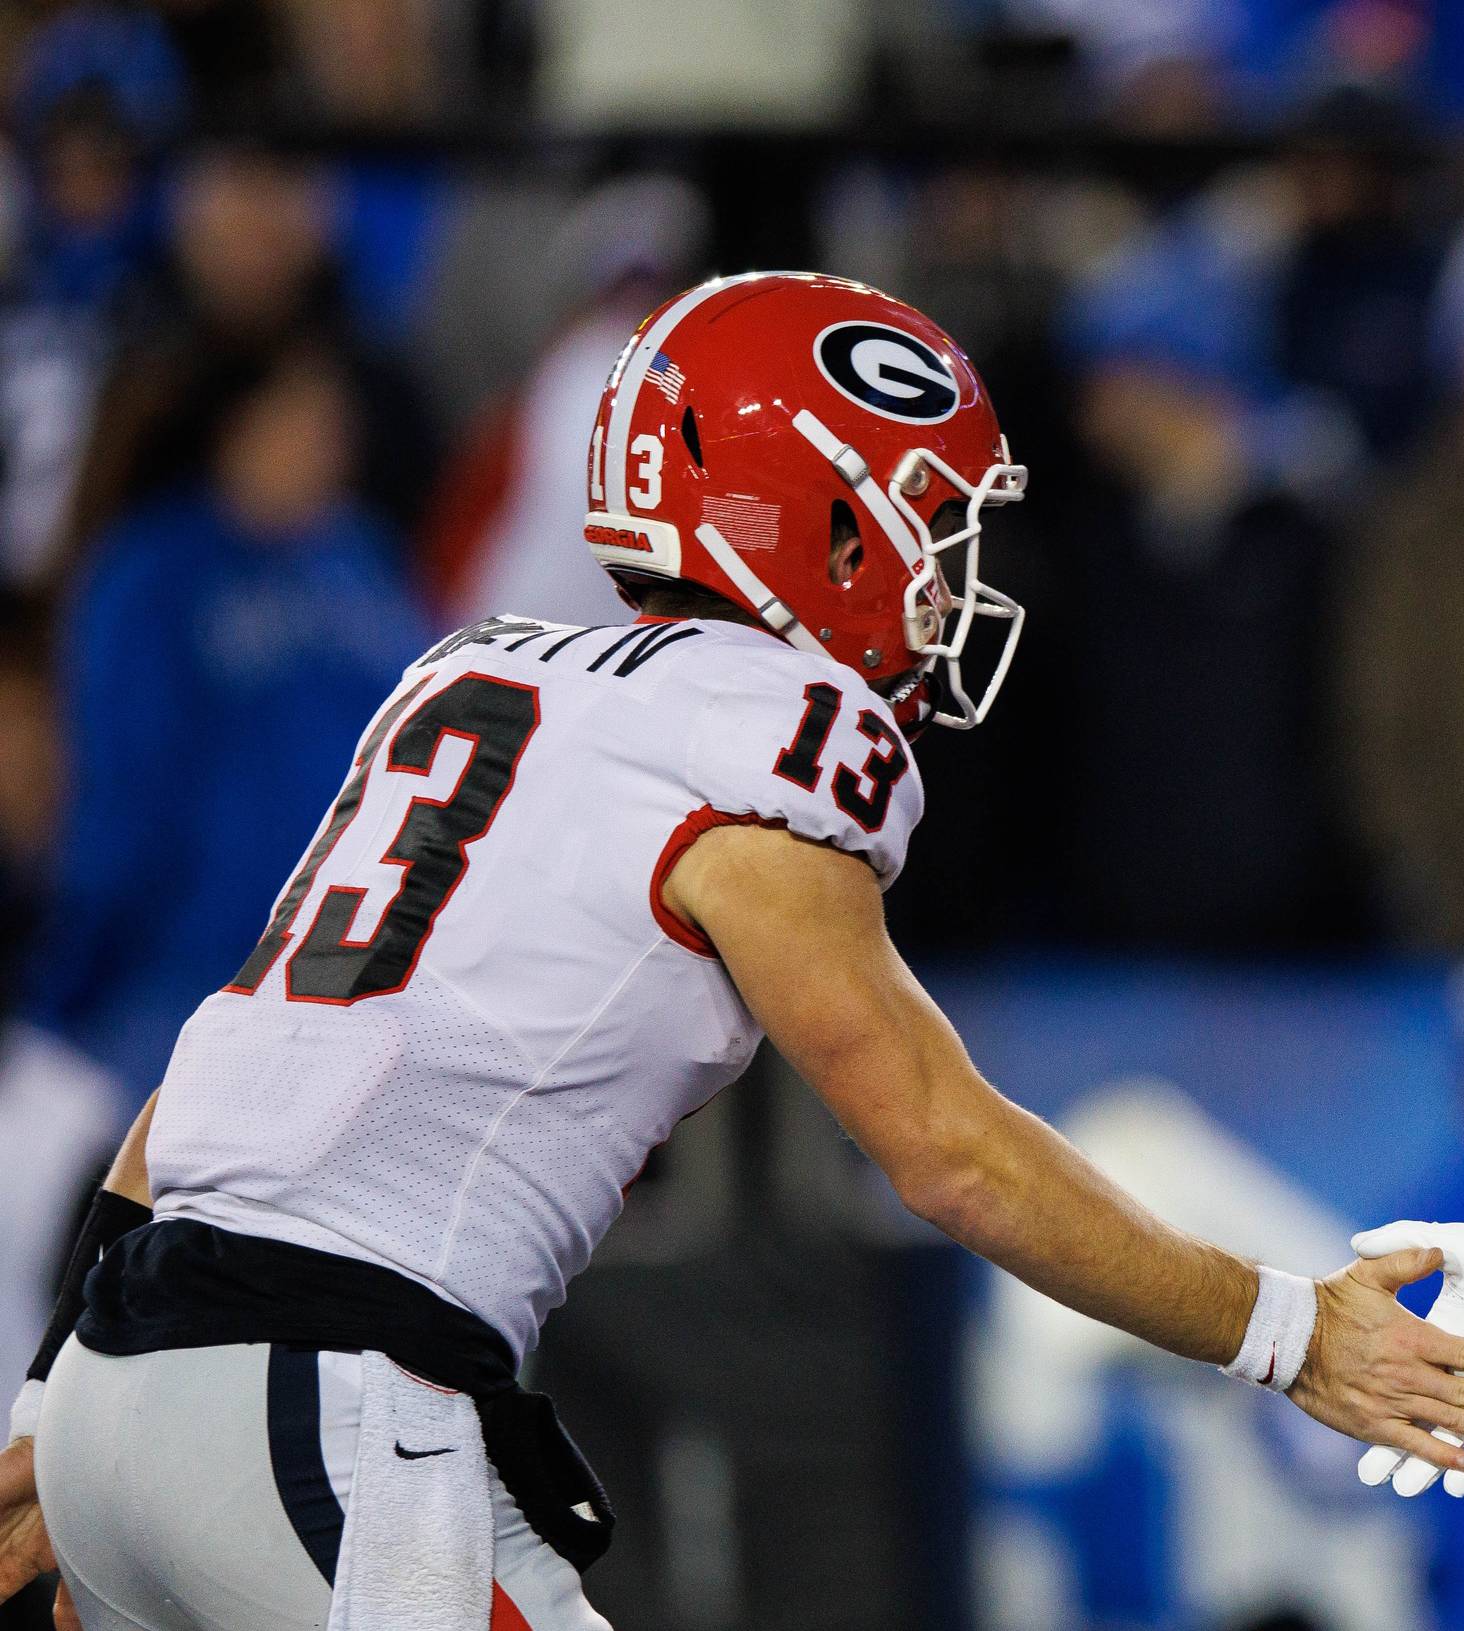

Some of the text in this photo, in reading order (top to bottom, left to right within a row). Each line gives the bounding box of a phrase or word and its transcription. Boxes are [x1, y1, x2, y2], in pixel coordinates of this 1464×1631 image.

[813, 321, 960, 425] G
[772, 682, 909, 834] 13
[219, 671, 541, 1007] 13
